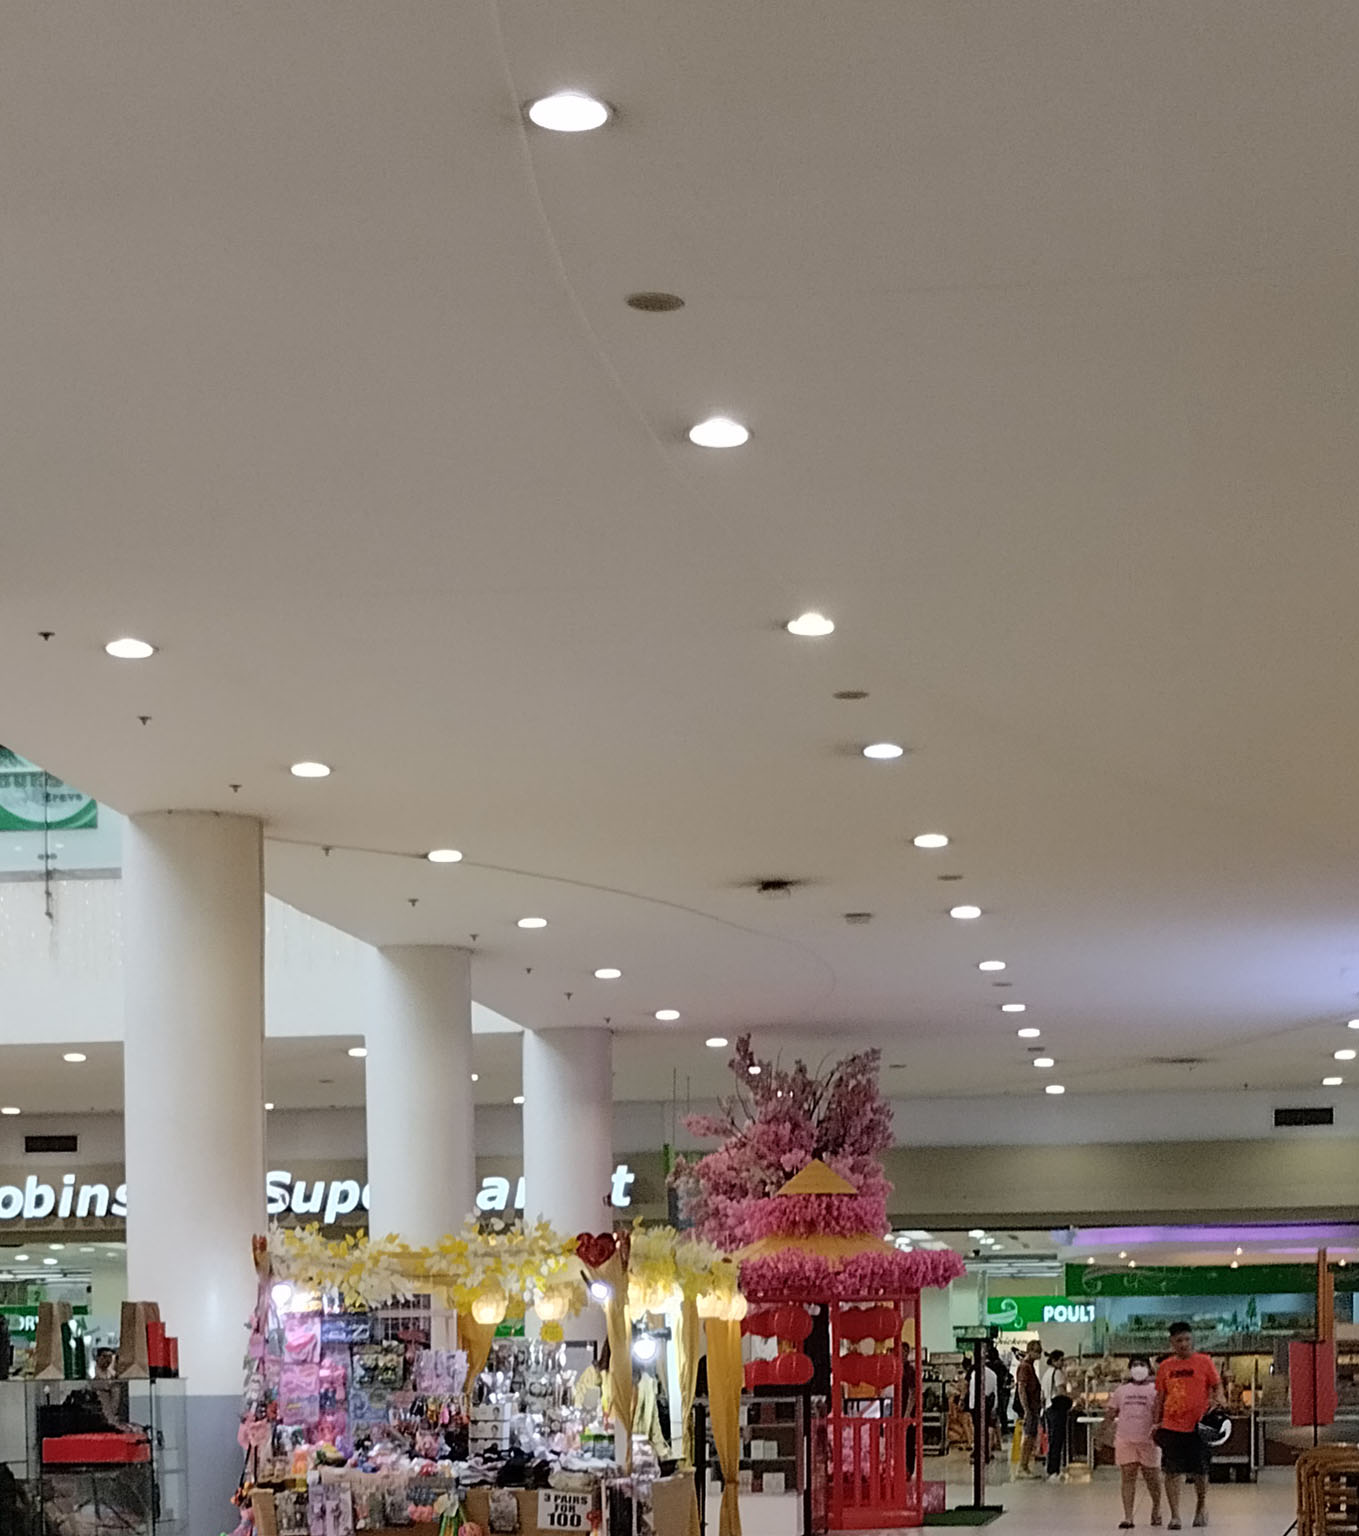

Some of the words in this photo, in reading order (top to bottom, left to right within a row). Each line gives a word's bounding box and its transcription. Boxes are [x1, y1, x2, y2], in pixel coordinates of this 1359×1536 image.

[1043, 1304, 1095, 1323] POULT
[544, 1493, 551, 1502] 3
[554, 1495, 588, 1505] PAIRS
[554, 1504, 576, 1513] FOR
[548, 1513, 582, 1527] 100
